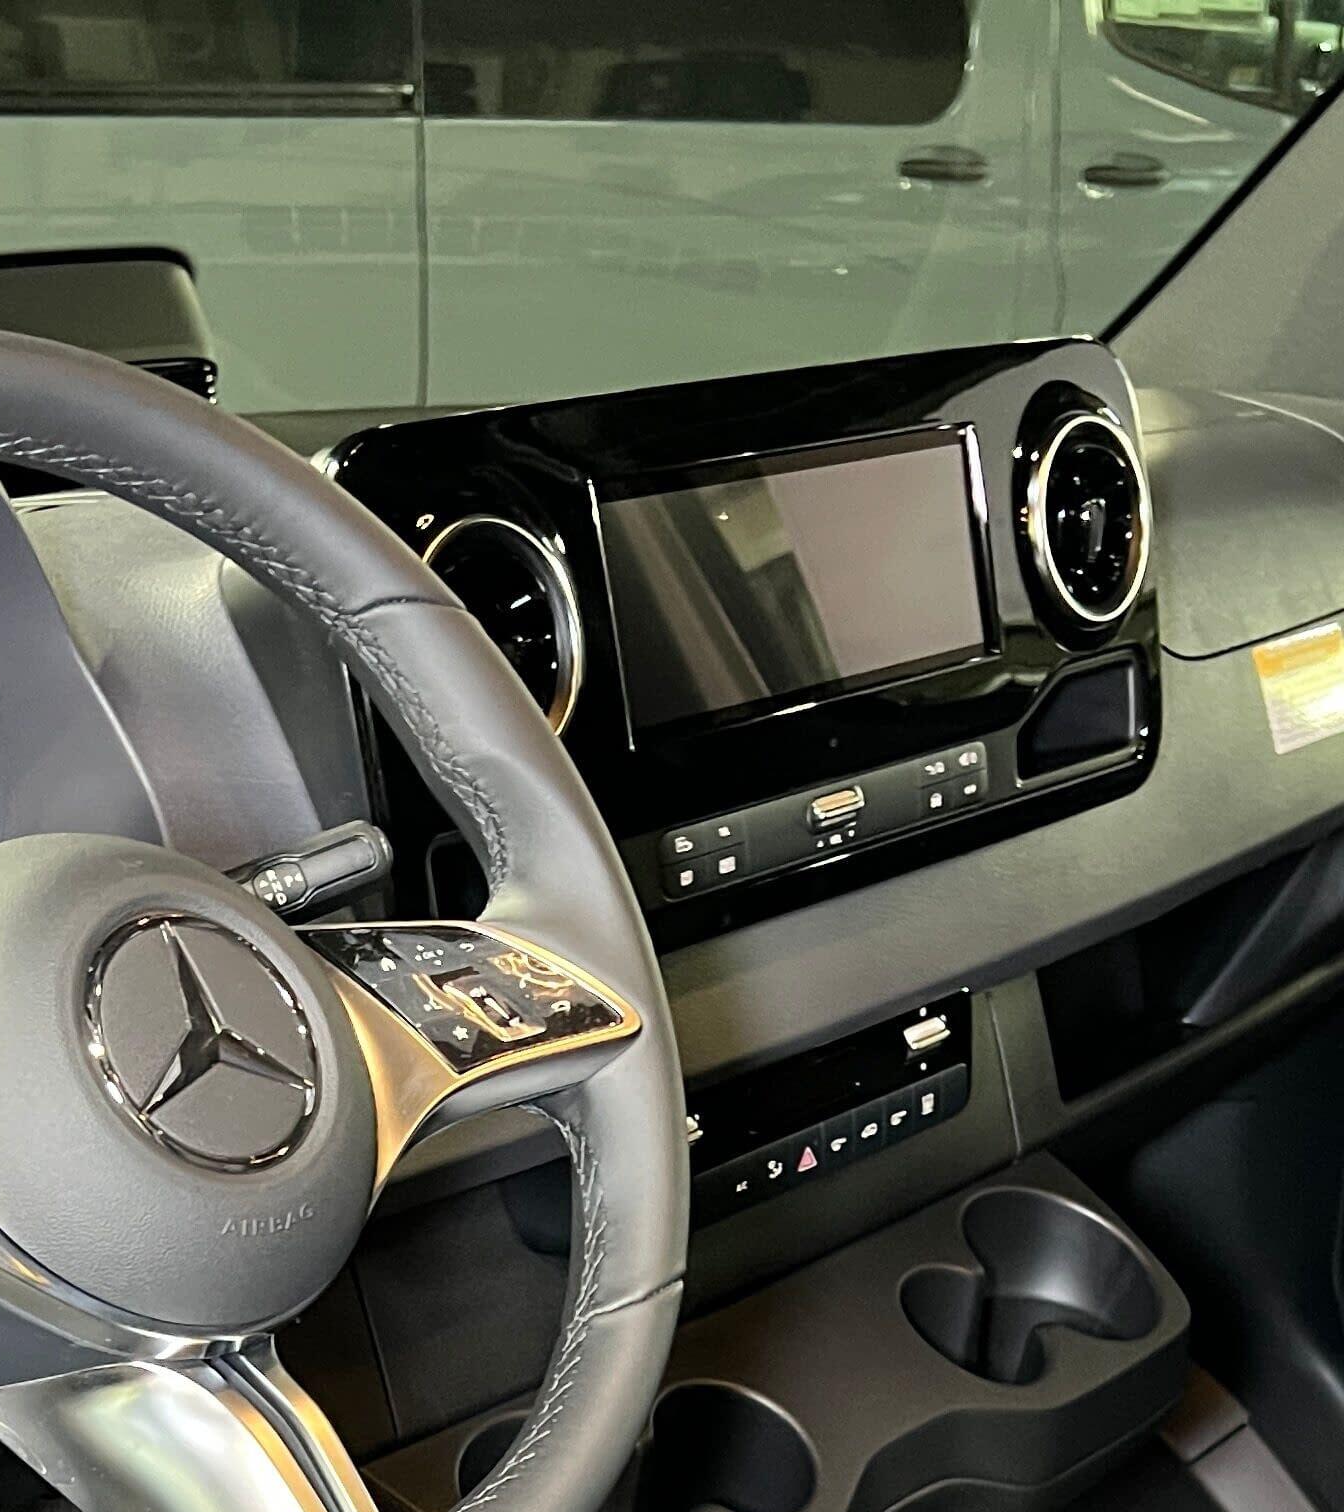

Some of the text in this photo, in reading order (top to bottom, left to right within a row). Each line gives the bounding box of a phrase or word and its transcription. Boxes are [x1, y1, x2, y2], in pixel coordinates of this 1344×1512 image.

[284, 875, 294, 888] P
[276, 893, 287, 906] D
[220, 1202, 315, 1236] AIRBAG
